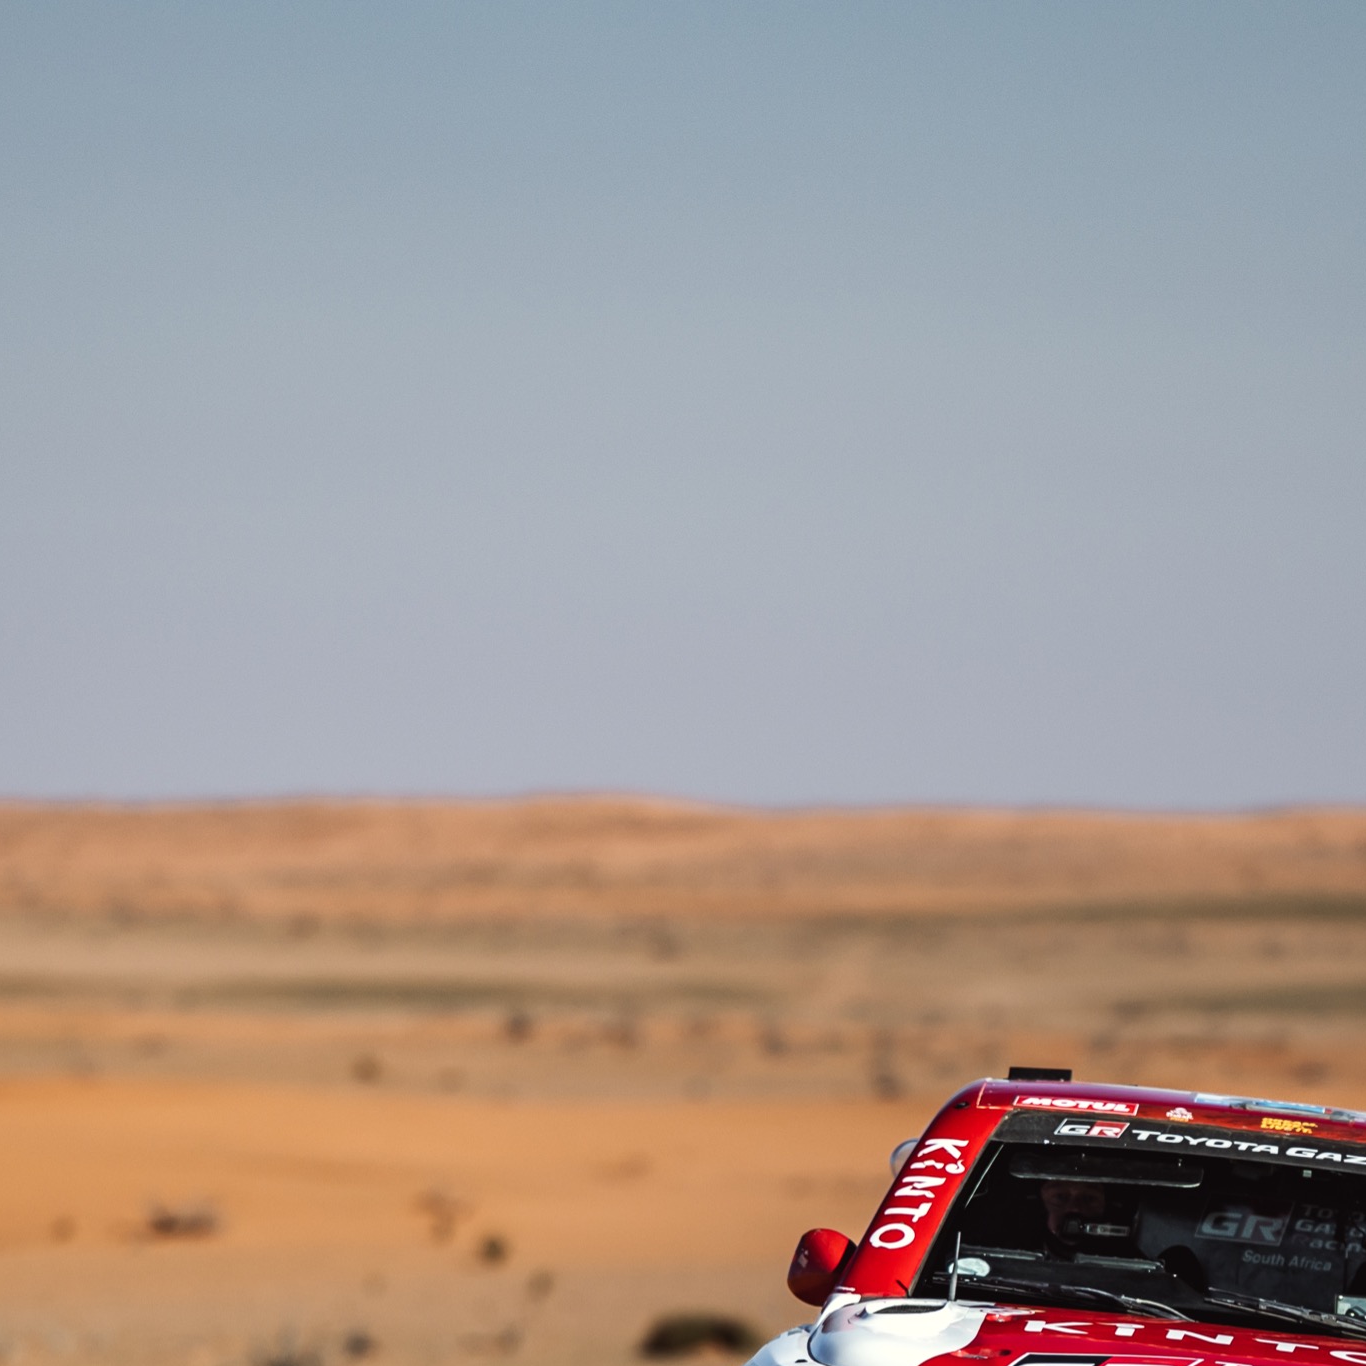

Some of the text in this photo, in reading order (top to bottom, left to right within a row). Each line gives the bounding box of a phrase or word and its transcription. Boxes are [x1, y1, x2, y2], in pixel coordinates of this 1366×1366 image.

[1022, 1097, 1131, 1113] MOTUL
[1060, 1124, 1122, 1138] GR
[1132, 1129, 1279, 1155] TOYOTA
[1201, 1211, 1284, 1242] GR
[1242, 1249, 1332, 1272] South Africa
